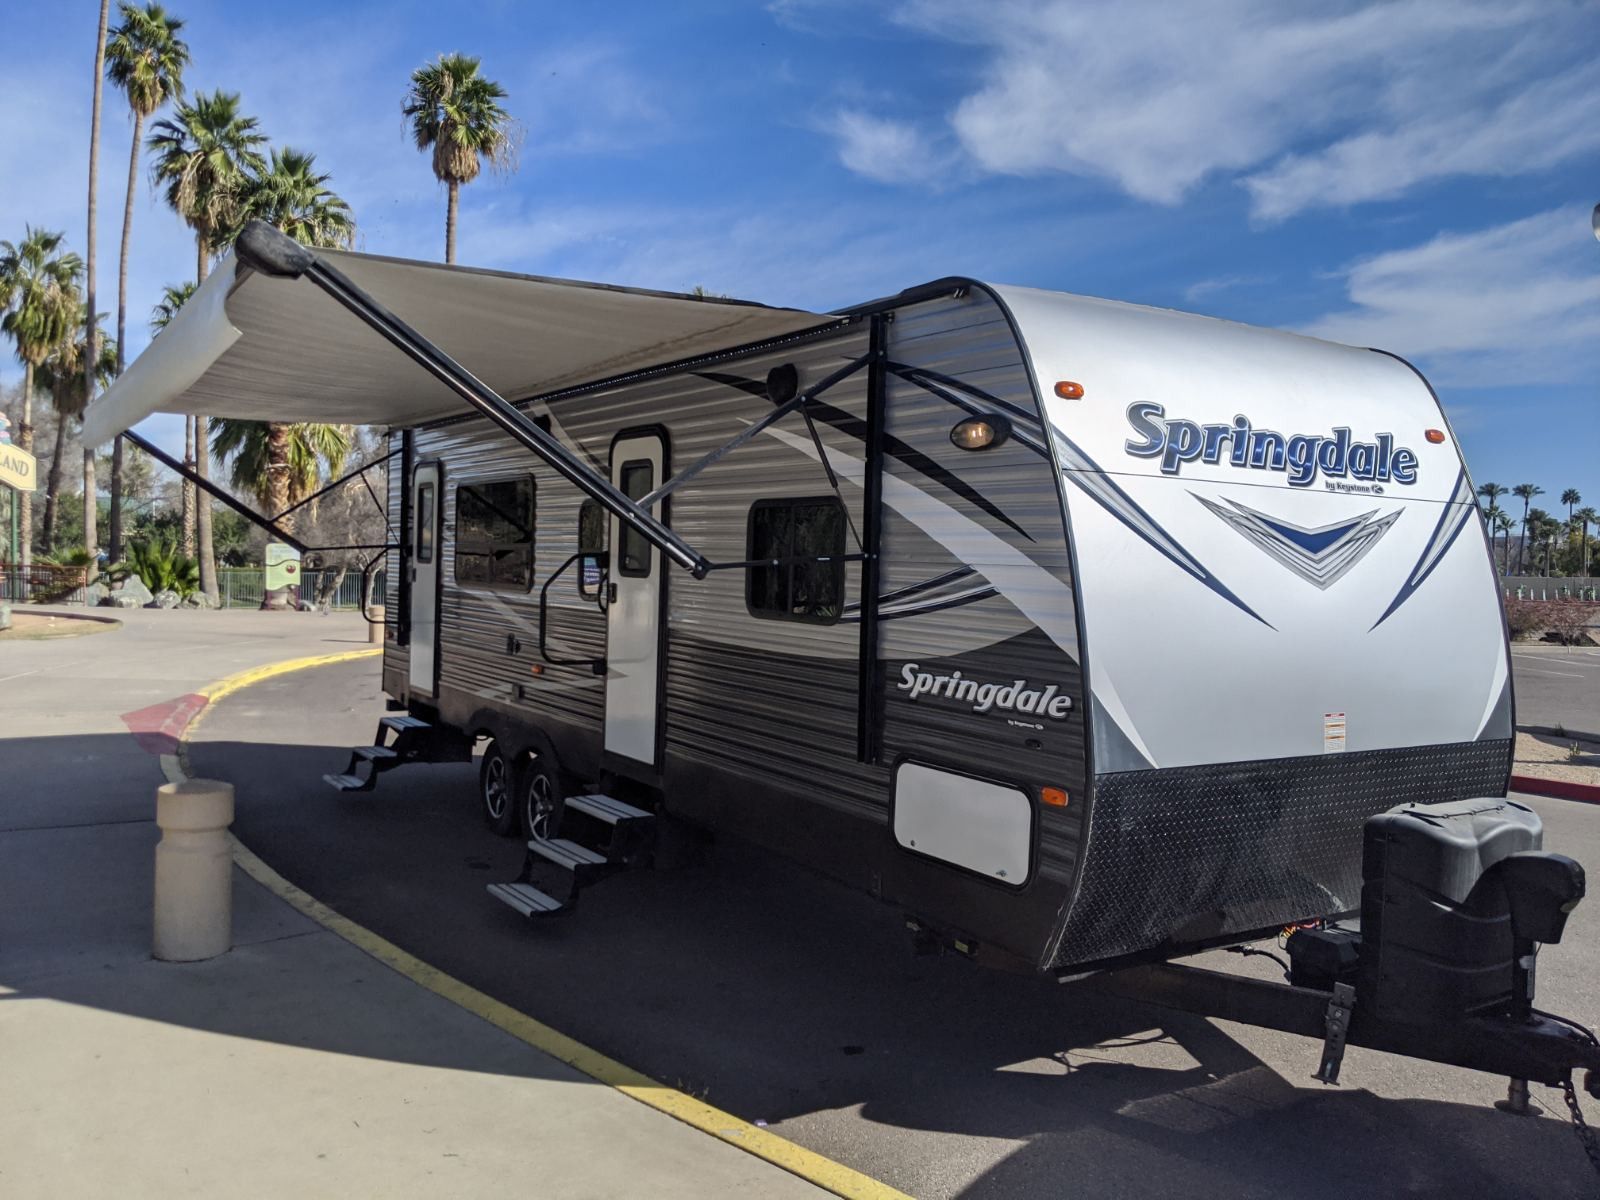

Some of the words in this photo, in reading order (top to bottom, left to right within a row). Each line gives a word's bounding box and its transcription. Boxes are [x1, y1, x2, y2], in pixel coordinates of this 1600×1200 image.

[1125, 401, 1419, 485] Springdale
[1325, 480, 1335, 491] by
[1336, 481, 1370, 493] Keystone
[898, 663, 1072, 718] Springdale
